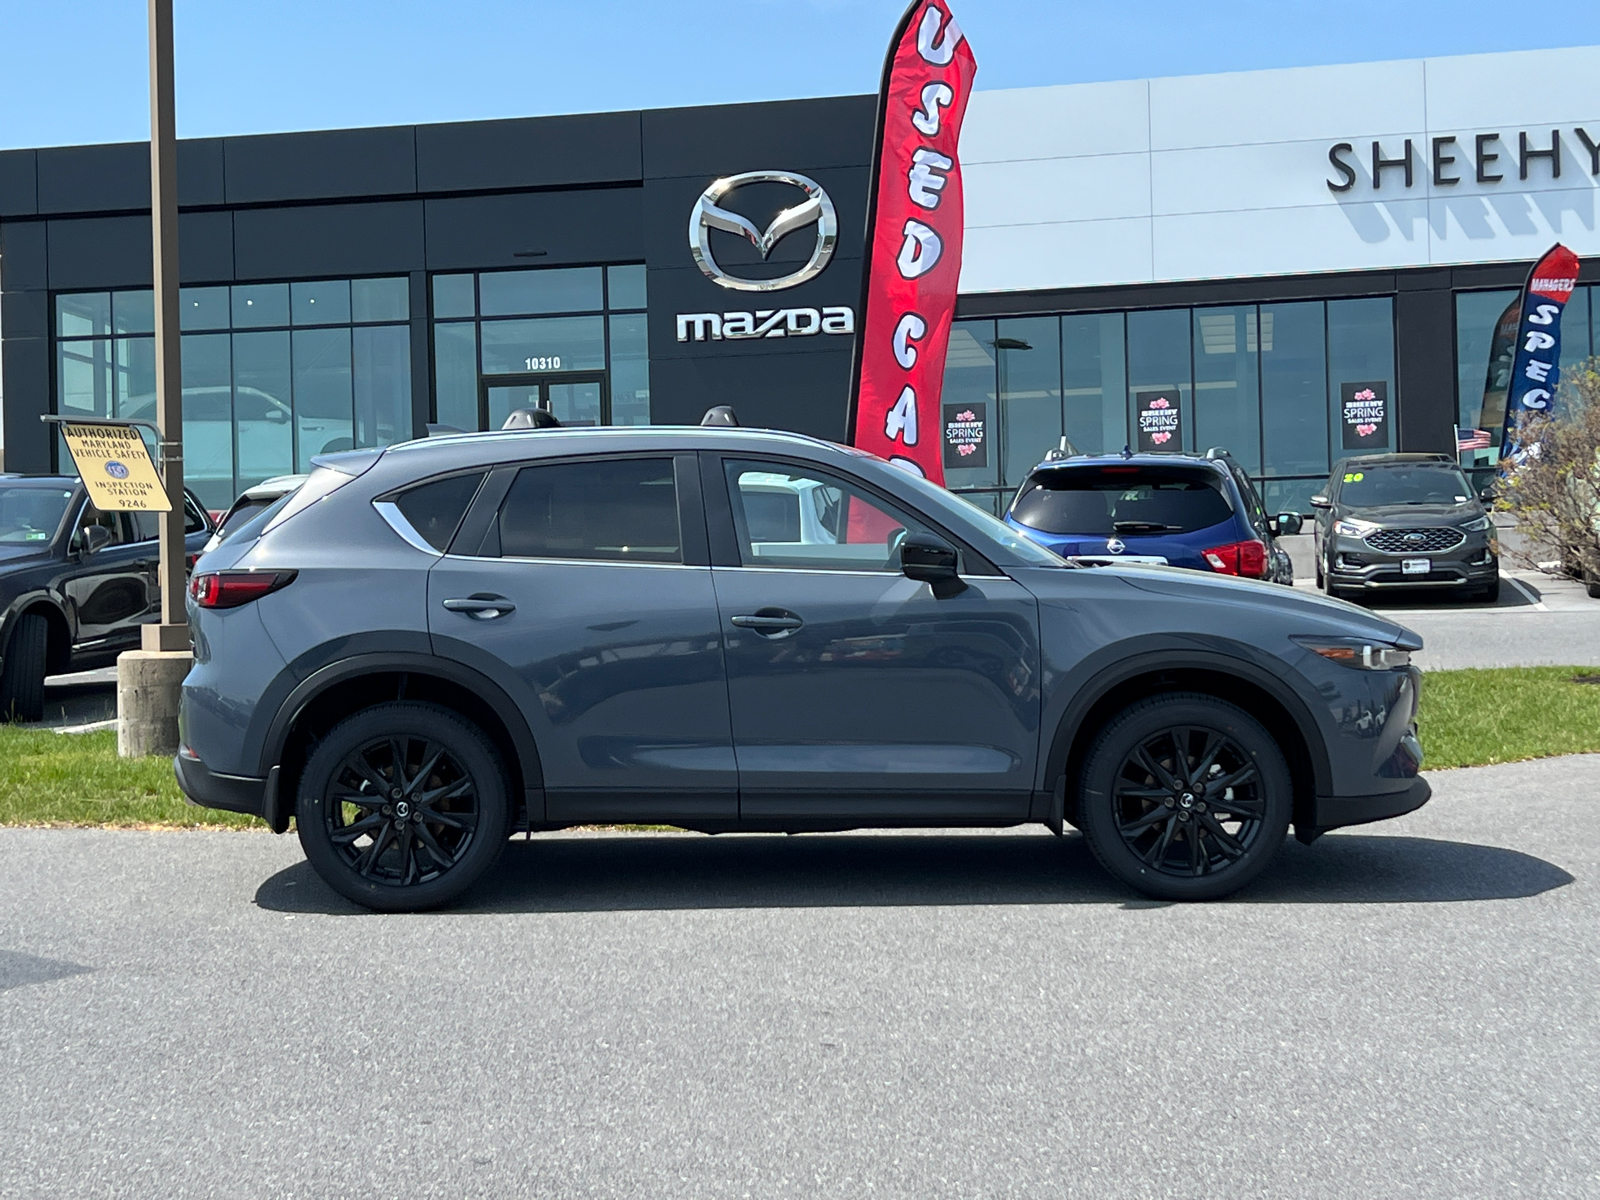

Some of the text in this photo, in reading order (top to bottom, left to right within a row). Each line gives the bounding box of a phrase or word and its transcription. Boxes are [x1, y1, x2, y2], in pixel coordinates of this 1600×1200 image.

[1326, 127, 1600, 192] SHEEHY
[884, 3, 964, 479] USED CA
[1531, 278, 1576, 292] MANAGERS
[1522, 304, 1560, 409] SPEC
[525, 356, 561, 370] 10310
[1344, 407, 1383, 418] SPRING
[1140, 416, 1178, 427] SPRING
[67, 428, 137, 440] AUTHORIZED
[946, 428, 983, 438] SPRING
[81, 440, 131, 449] MARYLAND
[73, 449, 146, 459] VEHICLE SAFETY
[1344, 473, 1363, 482] 20
[95, 481, 153, 489] INSPECTION
[119, 500, 147, 508] 9246
